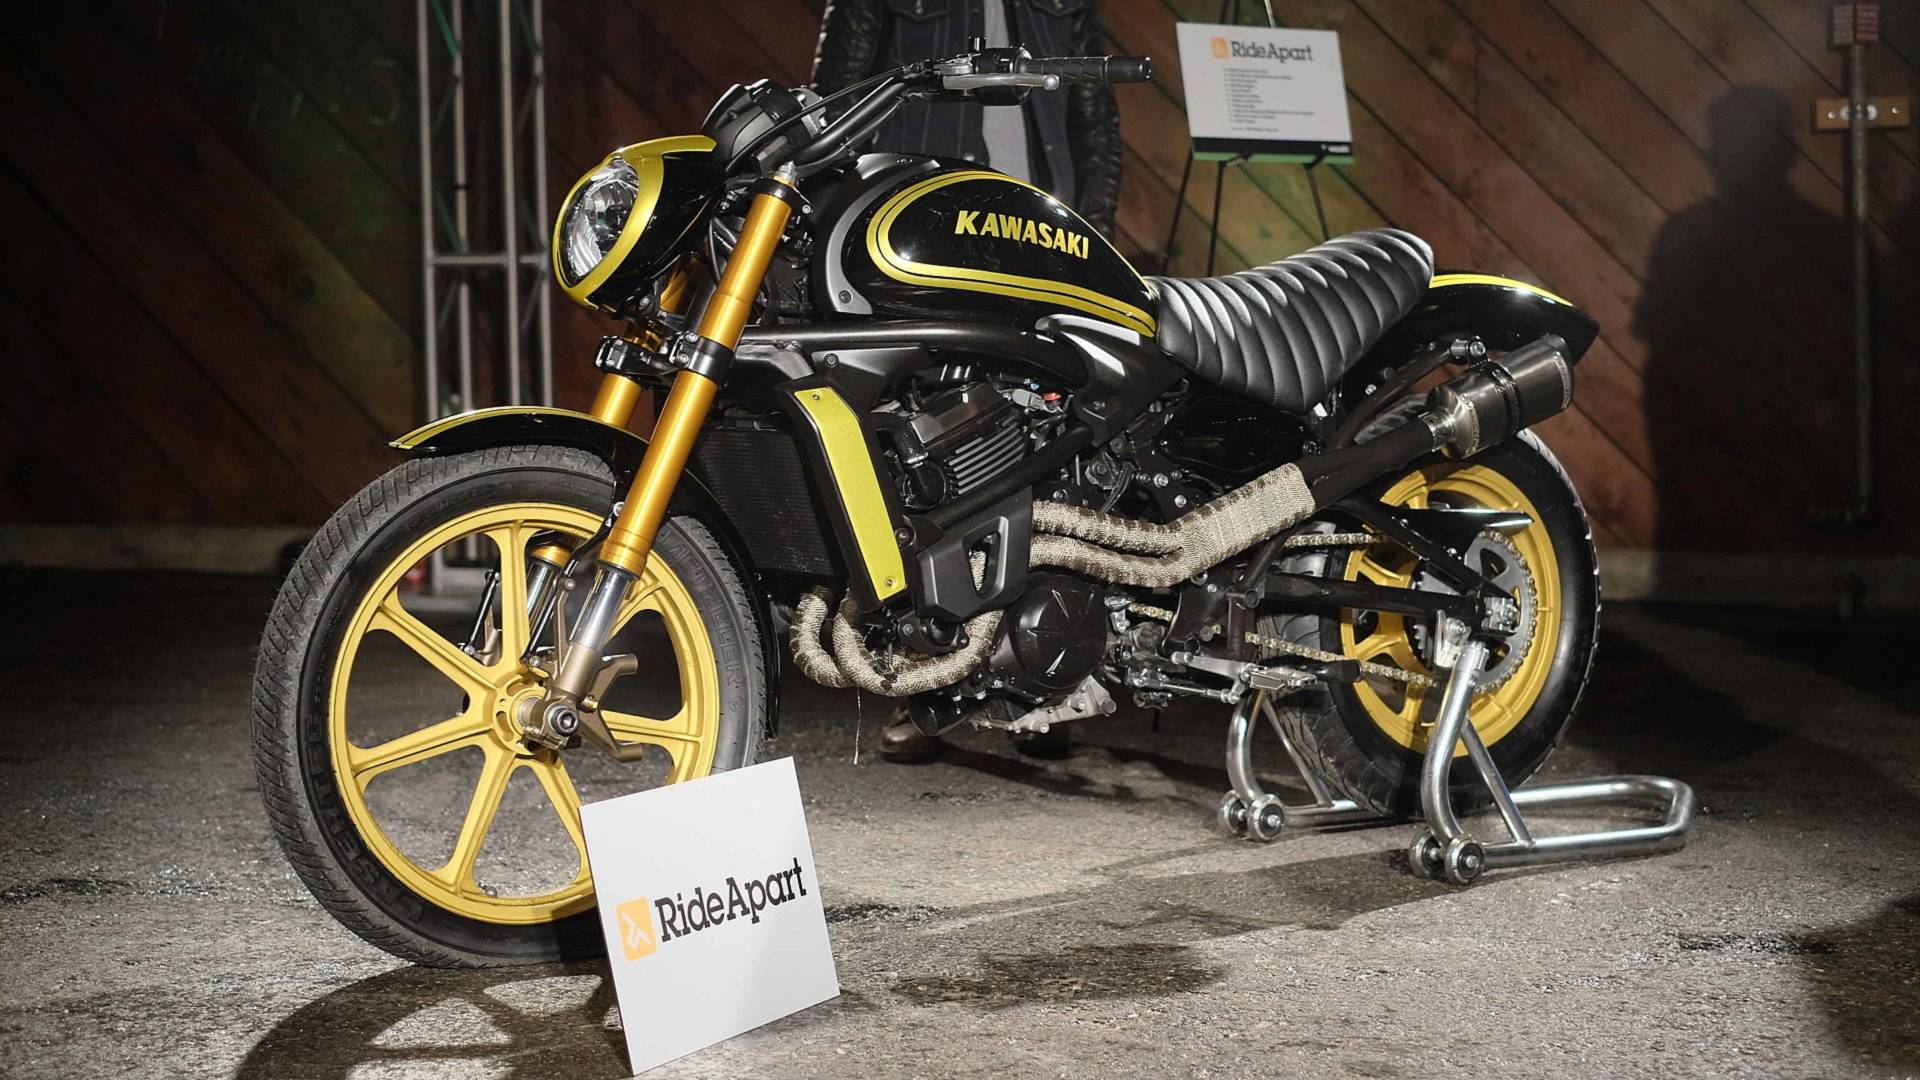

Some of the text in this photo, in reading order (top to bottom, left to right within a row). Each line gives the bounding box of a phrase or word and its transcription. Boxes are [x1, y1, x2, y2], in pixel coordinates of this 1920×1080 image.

[1231, 40, 1313, 63] RideApart
[954, 210, 1089, 260] KAWASAKI
[654, 856, 807, 943] RideApart
